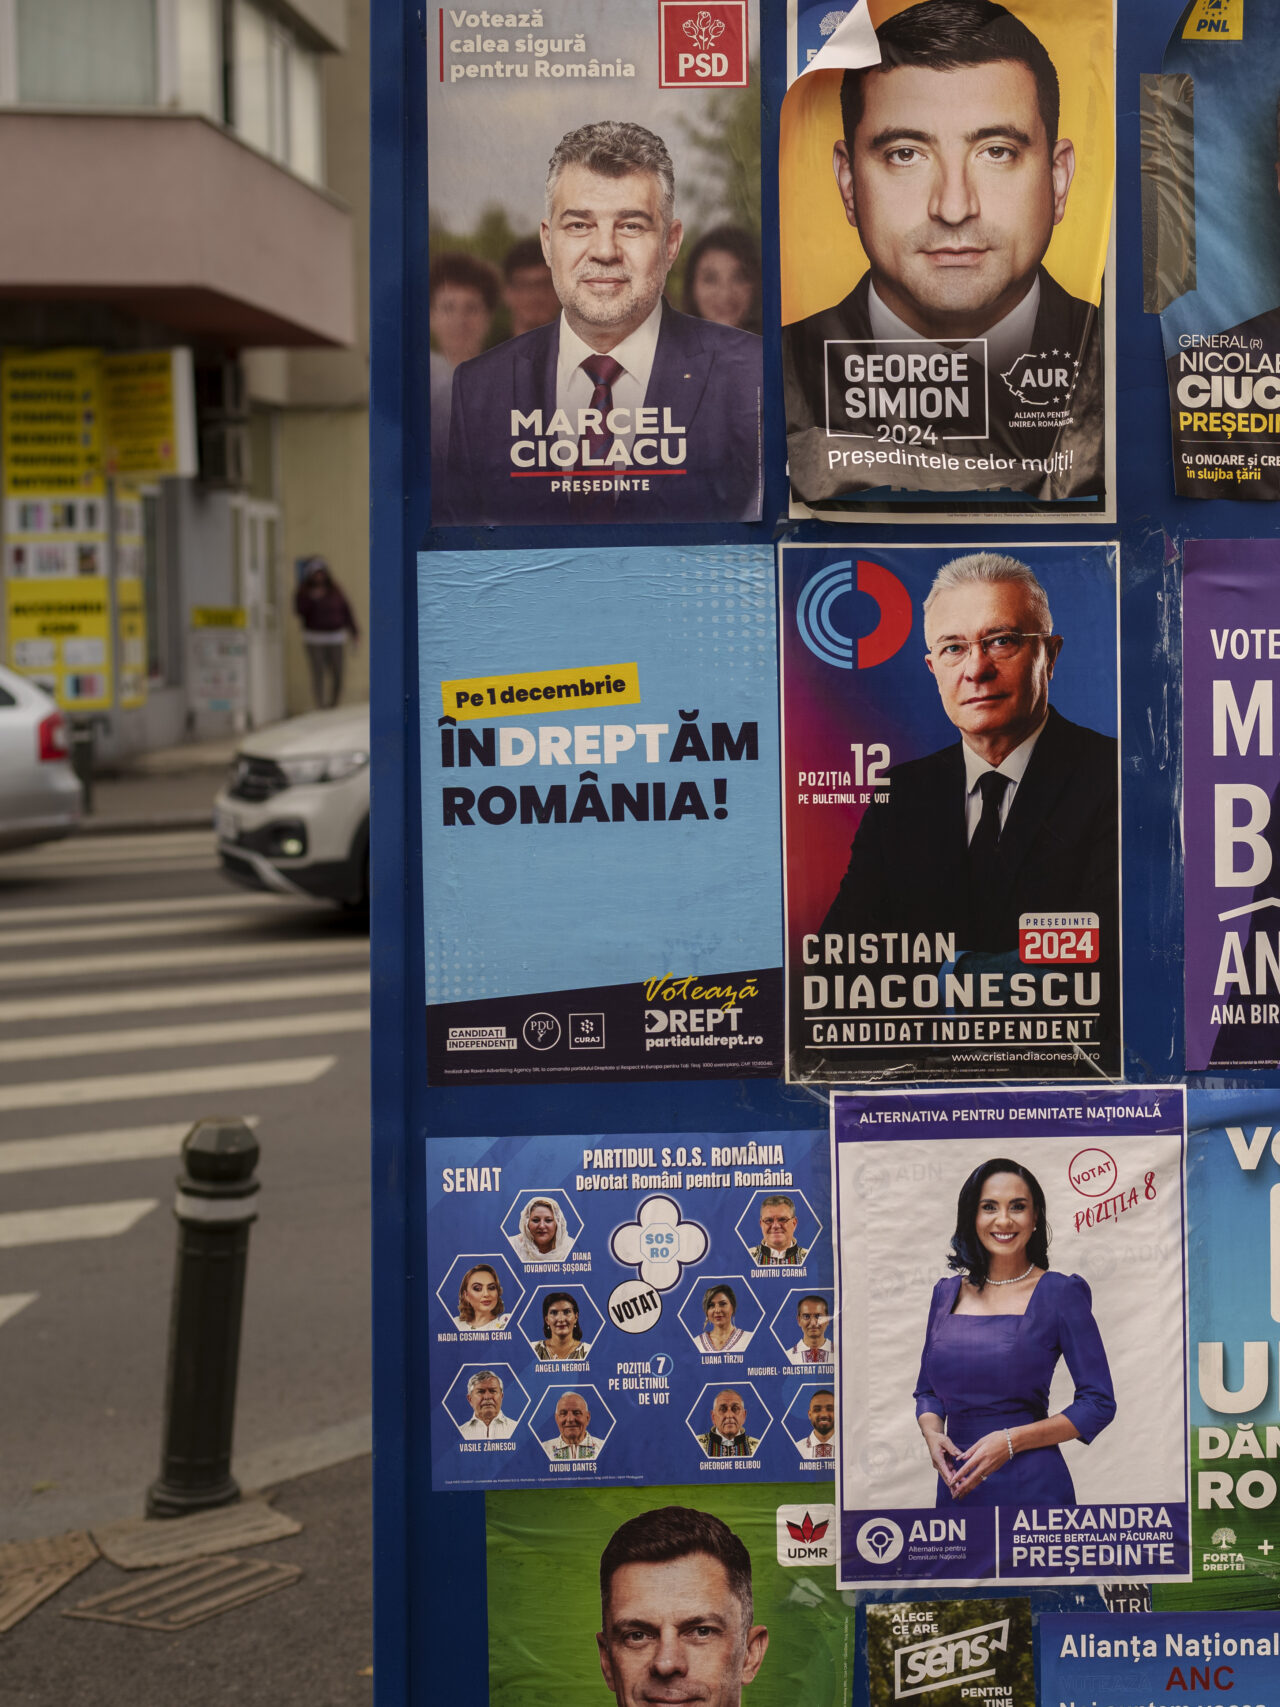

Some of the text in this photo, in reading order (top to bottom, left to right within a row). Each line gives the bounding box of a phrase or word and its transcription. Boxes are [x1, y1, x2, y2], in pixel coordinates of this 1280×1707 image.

[450, 9, 544, 28] Votează
[1196, 19, 1229, 32] PNL
[450, 33, 586, 57] calea sigură
[450, 59, 635, 83] pentru România
[679, 53, 728, 77] PSD
[1179, 334, 1263, 350] GENERAL (R)
[844, 353, 968, 383] GEORGE
[1020, 368, 1069, 388] AUR
[845, 386, 969, 419] SIMION
[510, 407, 686, 436] MARCEL
[1008, 420, 1036, 428] UNIREA
[1014, 411, 1045, 420] ALIANȚA
[877, 424, 938, 446] 2024
[510, 438, 687, 468] CIOLACU
[1182, 453, 1193, 464] Cu
[1195, 454, 1245, 466] ONOARE
[1248, 454, 1257, 469] și
[828, 449, 1074, 477] Președintele celor mulți!
[1187, 467, 1261, 483] în slujba țării
[551, 479, 650, 495] PREȘEDINTE
[455, 674, 626, 708] Pe 1 decembrie
[438, 709, 759, 768] ÎNDREPTĂM
[850, 743, 891, 786] 12
[798, 771, 852, 790] POZIȚIA
[442, 770, 728, 826] ROMÂNIA!
[798, 793, 890, 804] PE BULETINUL DE VOT
[1026, 917, 1092, 927] PREȘEDINTE
[802, 932, 956, 965] CRISTIAN
[1024, 930, 1093, 960] 2024
[642, 971, 758, 1013] Votează
[803, 972, 1100, 1010] DIACONESCU
[645, 1007, 743, 1033] DREPT
[1210, 1004, 1246, 1025] ANA
[451, 1029, 503, 1039] CANDIDAȚI
[531, 1020, 554, 1031] PDU
[812, 1020, 1093, 1044] CANDIDAT INDEPENDENT
[448, 1039, 514, 1050] INDEPENDENȚI
[574, 1036, 600, 1044] CURAJ
[645, 1033, 764, 1051] partiduldrept.ro
[951, 1051, 1100, 1063] www.cristiandiaconescuro
[860, 1103, 1162, 1124] ALTERNATIVA PENTRU DEMNITATE NAȚIONALĂ
[583, 1142, 784, 1169] PARTIDUL S.O.S. ROMÂNIA
[442, 1167, 502, 1193] SENAT
[576, 1169, 793, 1191] DeVotat Români pentru România
[1073, 1161, 1112, 1185] VOTAT
[1074, 1172, 1157, 1232] POZIȚIA 8
[645, 1233, 674, 1244] SOS
[572, 1252, 591, 1261] DIANA
[650, 1247, 669, 1258] RO
[751, 1269, 780, 1278] DUMITRU
[611, 1289, 658, 1324] VOTAT
[438, 1332, 512, 1342] NADIA COSMINA CERVA
[535, 1361, 590, 1373] ANGELA NEGROTĂ
[617, 1357, 666, 1377] POZIȚIA 7
[701, 1355, 722, 1365] LUANA
[782, 1366, 816, 1375] CALISTRAT
[609, 1377, 670, 1390] PE BULETINUL
[638, 1392, 670, 1405] DE VOT
[459, 1443, 481, 1452] VASILE
[549, 1463, 570, 1472] OVIDIU
[700, 1461, 761, 1470] GHEORGHE BELIBOU
[1012, 1506, 1172, 1531] ALEXANDRA
[908, 1519, 967, 1542] ADN
[1013, 1530, 1173, 1544] BEATRICE BERTALAN PĂCURARU
[788, 1547, 828, 1559] UDMR
[945, 1545, 966, 1553] pentru
[1203, 1553, 1244, 1563] FORȚA
[1012, 1543, 1175, 1574] PREȘEDINTE
[1203, 1562, 1245, 1571] DREPTEI
[892, 1612, 934, 1623] ALEGE
[893, 1624, 939, 1635] CE ARE
[1060, 1634, 1157, 1662] Alianța
[1165, 1633, 1279, 1662] Național
[905, 1634, 990, 1685] sens
[1165, 1665, 1234, 1691] ANC
[961, 1686, 1013, 1698] PENTRU
[984, 1698, 1013, 1707] TINE
